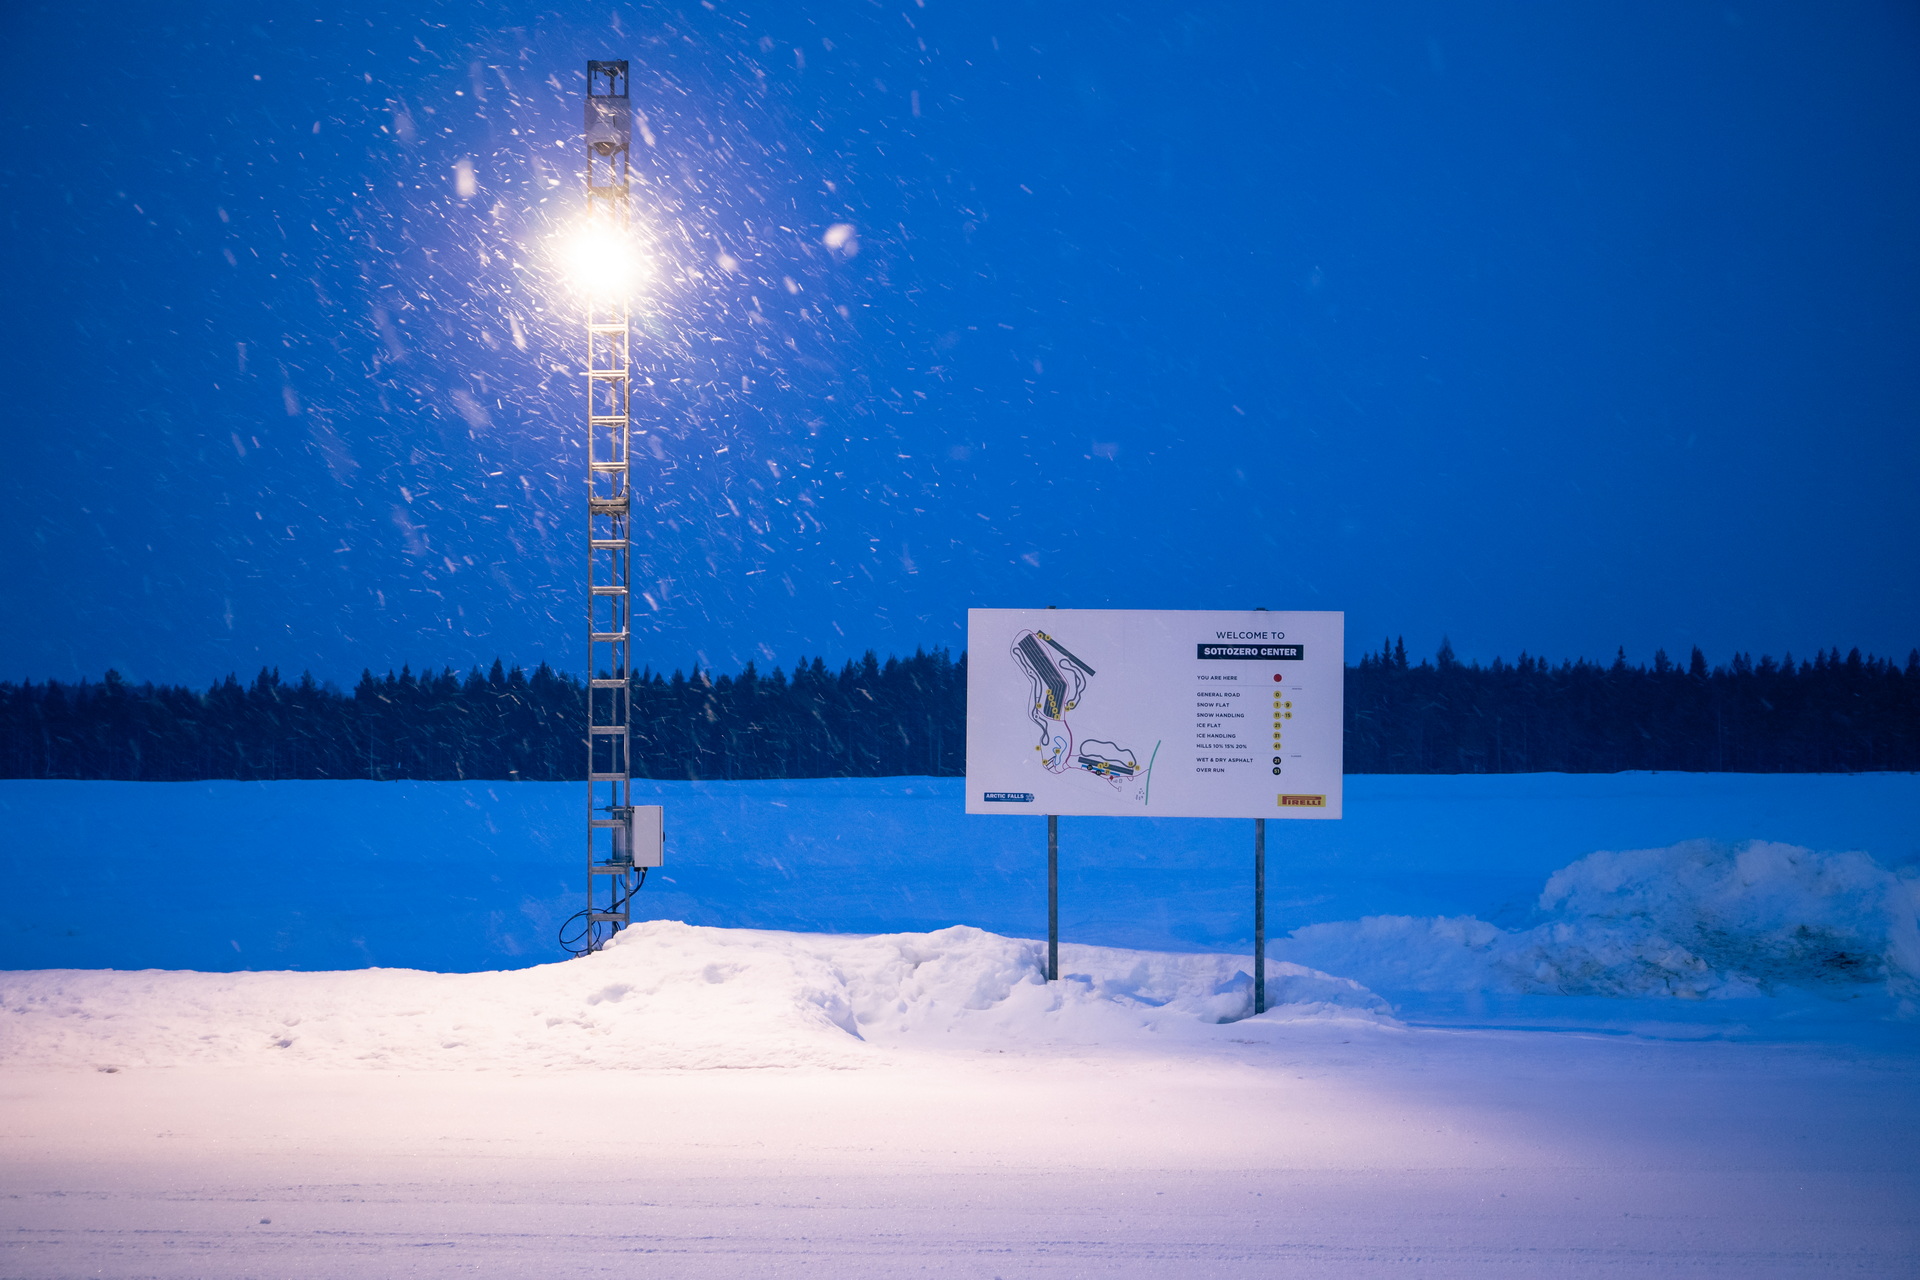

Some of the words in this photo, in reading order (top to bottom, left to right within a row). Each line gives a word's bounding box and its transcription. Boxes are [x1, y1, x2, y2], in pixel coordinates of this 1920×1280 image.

[1216, 631, 1268, 639] WELCOME
[1271, 632, 1285, 640] TO
[1204, 647, 1258, 656] SOTTOZERO
[1260, 648, 1297, 656] CENTER
[1282, 796, 1321, 805] PIRELLI
